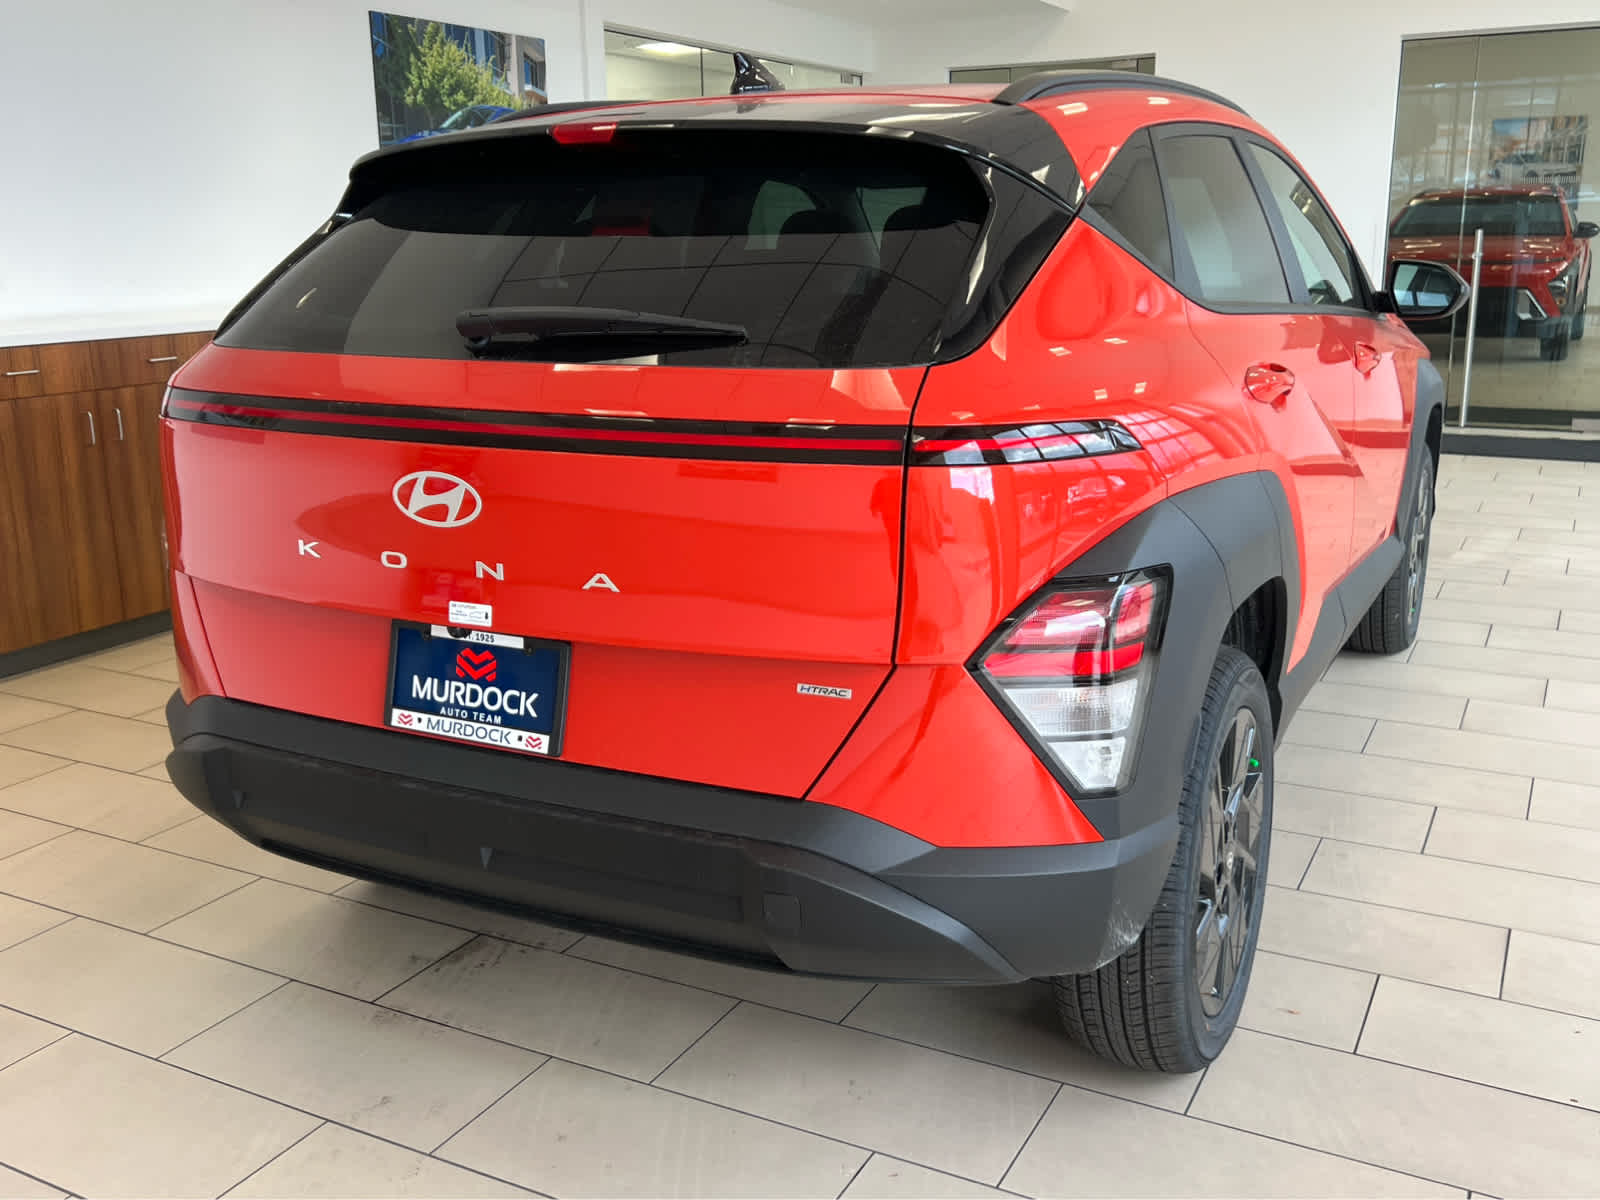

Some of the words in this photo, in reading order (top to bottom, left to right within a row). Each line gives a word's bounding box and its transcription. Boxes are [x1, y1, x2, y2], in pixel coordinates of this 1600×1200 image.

[475, 633, 495, 643] 1925
[412, 674, 539, 718] MURDOCK
[800, 685, 848, 697] HTRAC
[440, 707, 468, 719] AUTO
[472, 711, 502, 725] TEAM
[426, 717, 512, 745] MURDOCK
